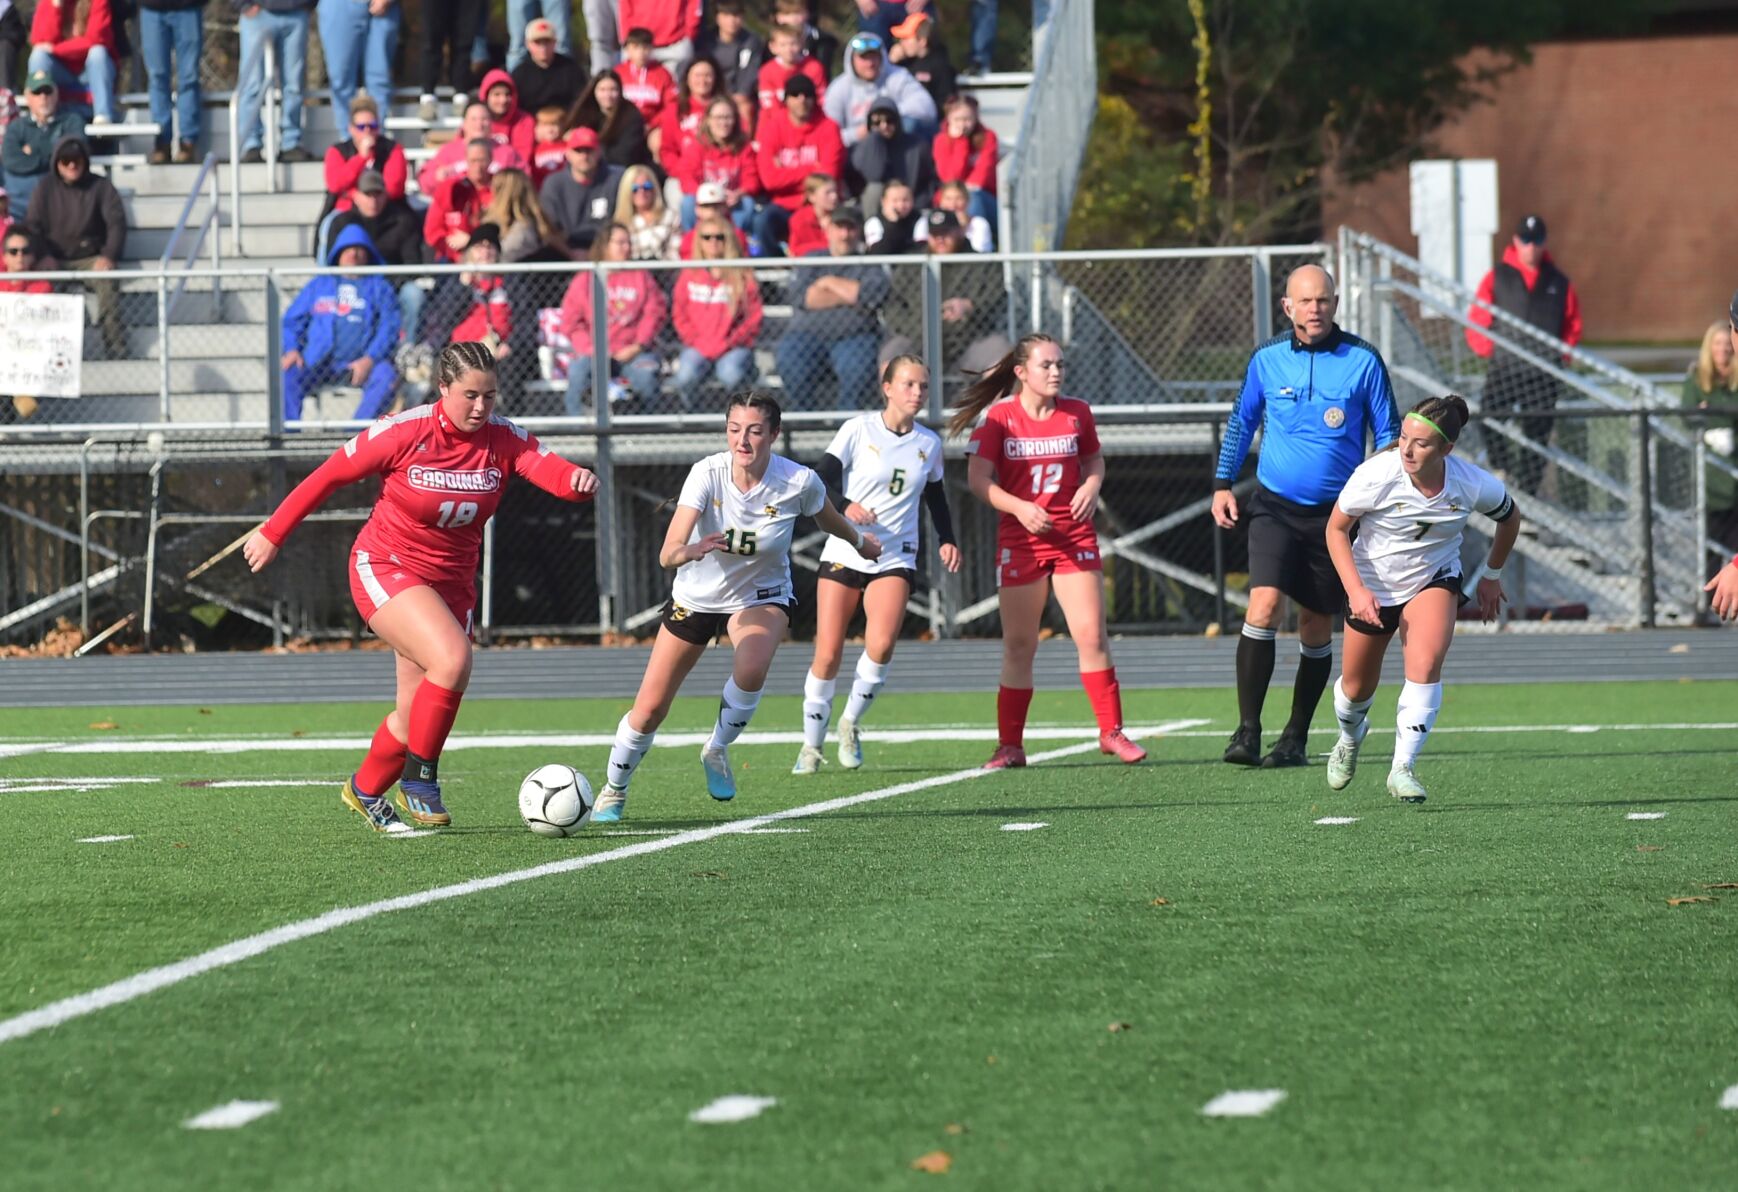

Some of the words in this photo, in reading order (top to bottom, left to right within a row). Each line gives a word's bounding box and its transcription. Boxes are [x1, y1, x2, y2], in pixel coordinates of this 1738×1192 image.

[409, 467, 499, 491] CARDINALS
[888, 468, 906, 497] 5
[1030, 463, 1063, 494] 12
[436, 501, 478, 528] 18
[721, 528, 756, 556] 15
[1414, 520, 1433, 541] 7
